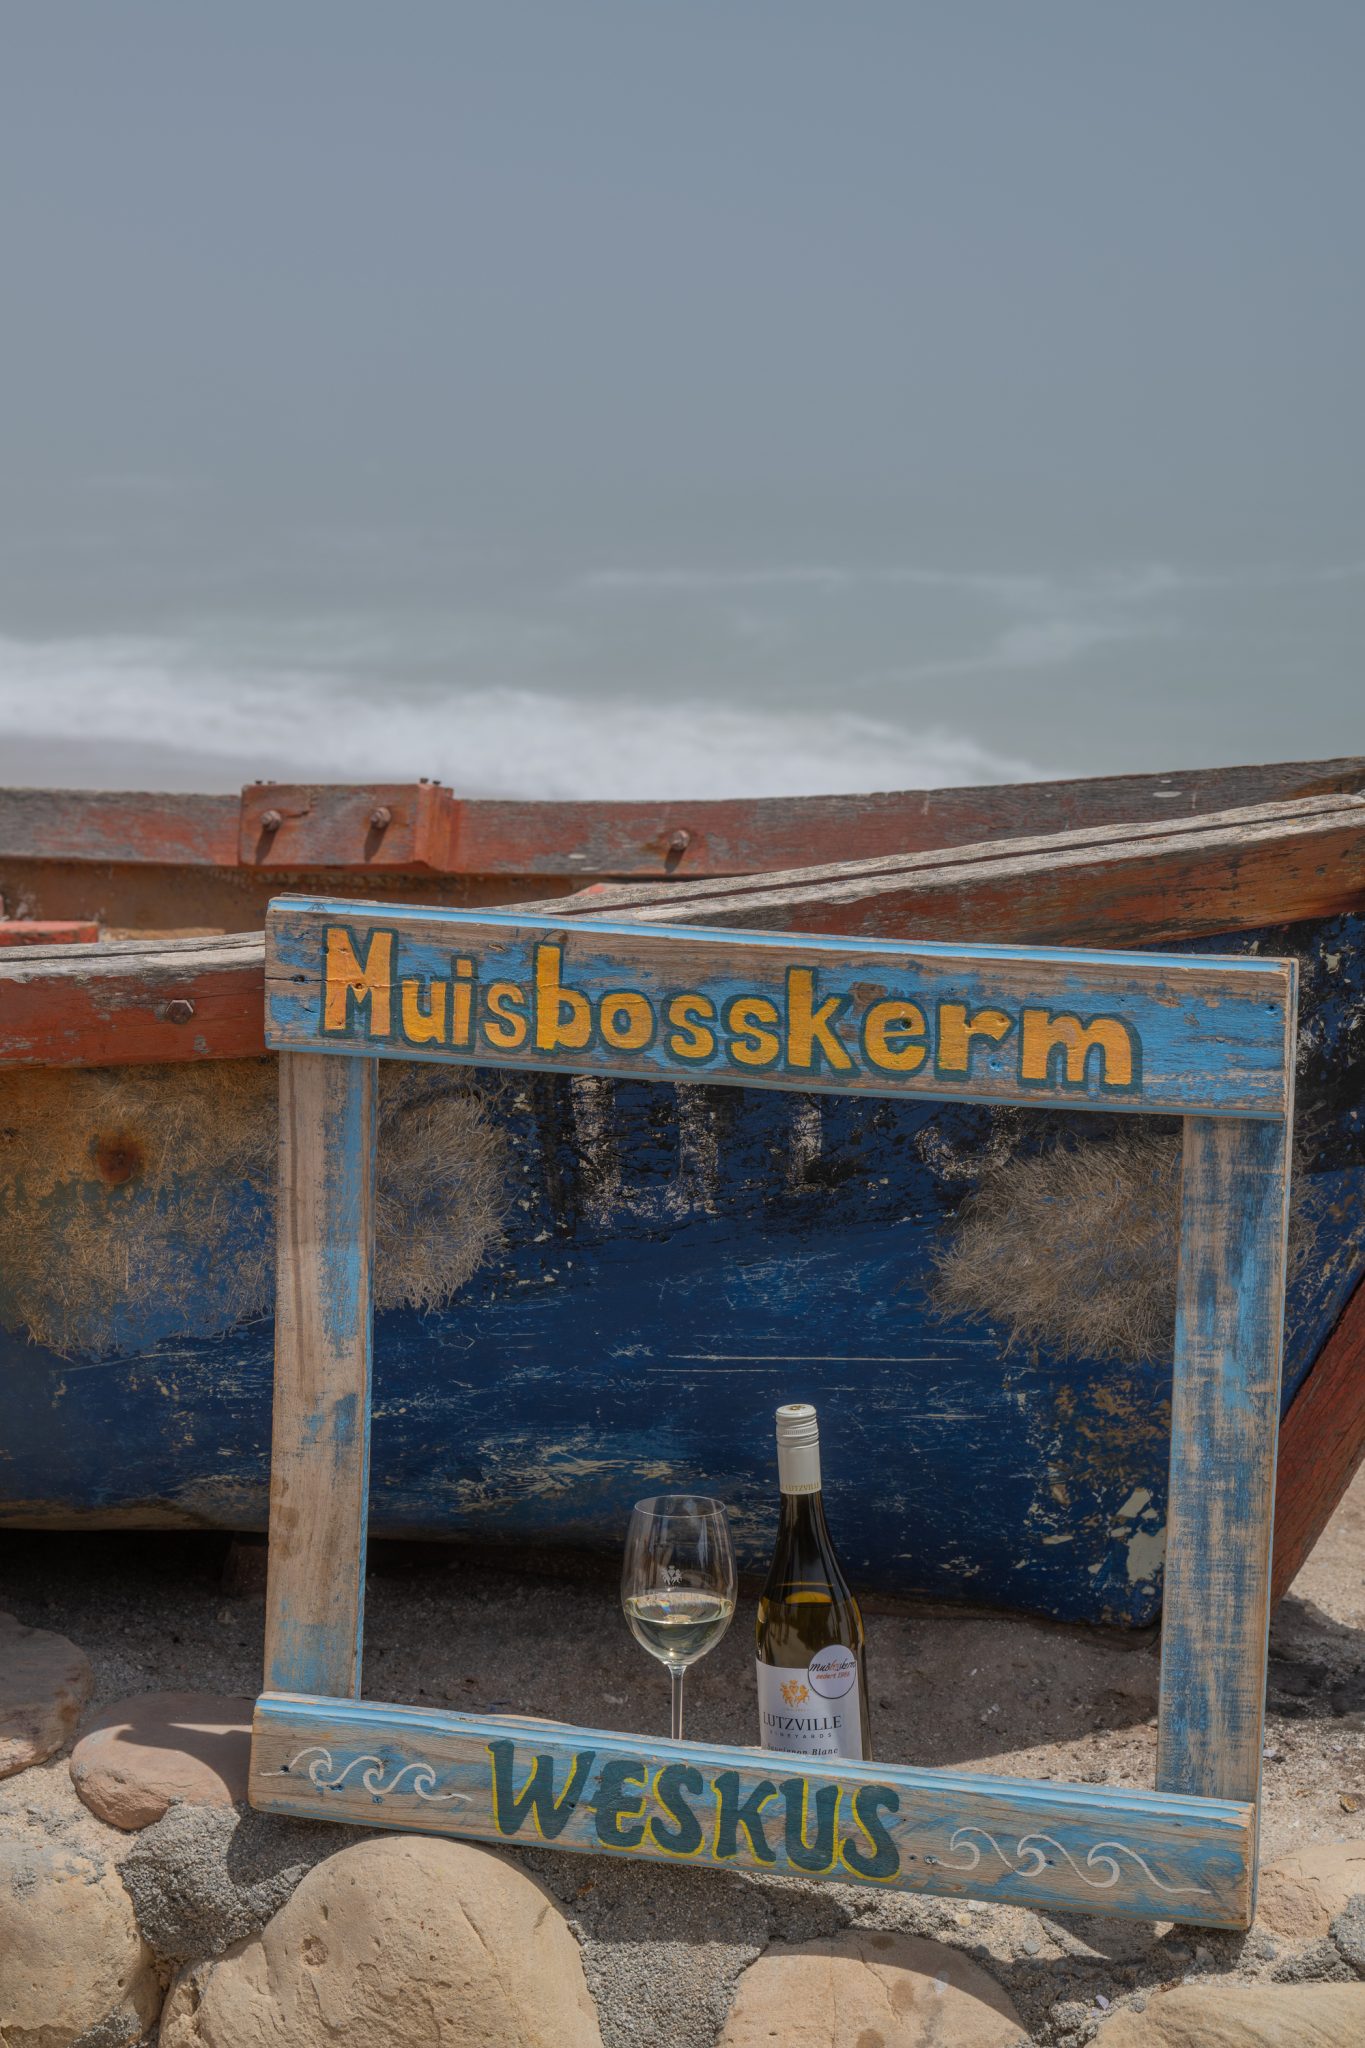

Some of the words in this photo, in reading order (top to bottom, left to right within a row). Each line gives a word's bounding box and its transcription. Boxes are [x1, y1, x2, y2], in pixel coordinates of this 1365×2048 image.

[320, 923, 1143, 1094] Muisbosskerm
[763, 1711, 842, 1731] LUTZVILLE
[769, 1730, 832, 1739] VINEYARDS
[811, 1747, 839, 1756] Blanc
[485, 1739, 901, 1883] WESKUS
